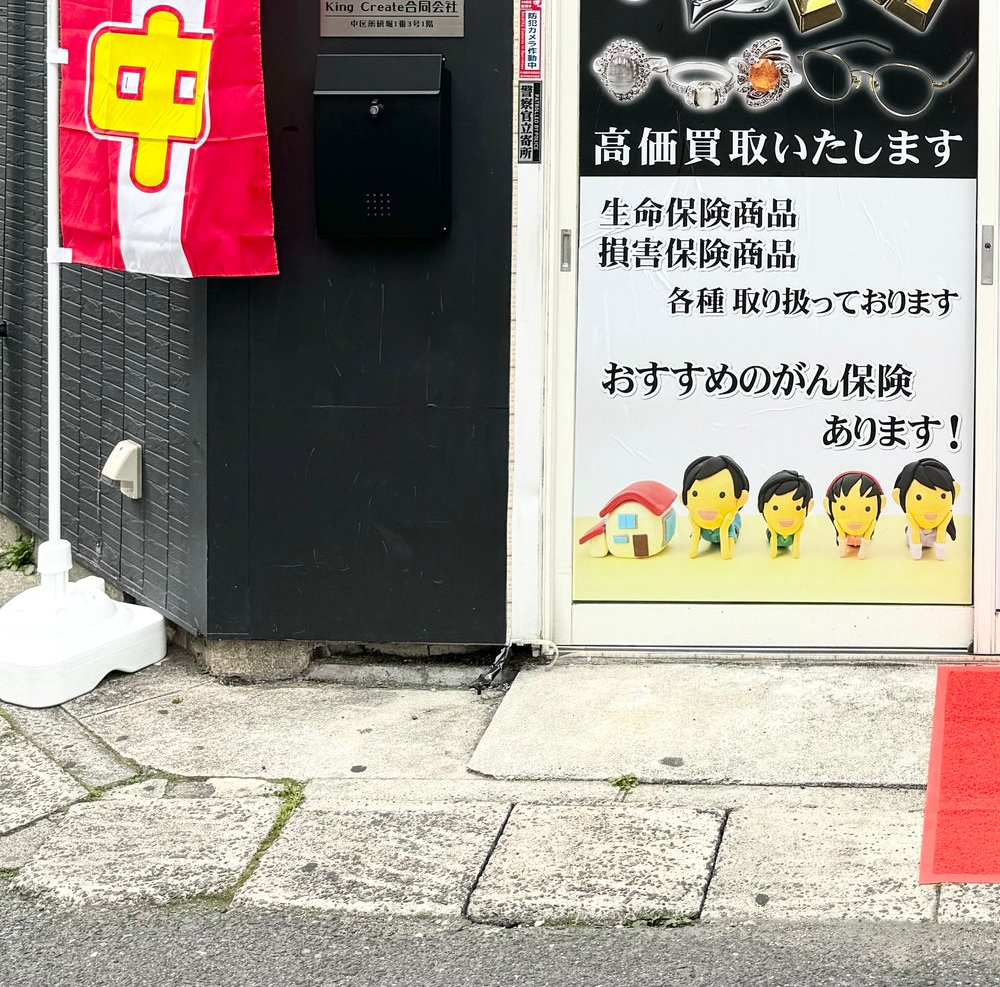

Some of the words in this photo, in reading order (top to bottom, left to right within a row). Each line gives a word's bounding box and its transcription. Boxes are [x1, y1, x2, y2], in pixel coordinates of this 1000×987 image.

[325, 1, 354, 13] King
[361, 0, 458, 13] Create合同会社
[527, 12, 538, 69] 防犯カメラ作動中
[520, 85, 533, 159] 警察官立寄所
[595, 127, 962, 167] 高価買取いたします
[600, 196, 798, 230] 生命保険商品
[598, 236, 798, 271] 損害保険商品
[667, 287, 725, 315] 各種
[732, 288, 960, 316] 取り扱っております
[601, 361, 914, 398] おすすめのがん保険
